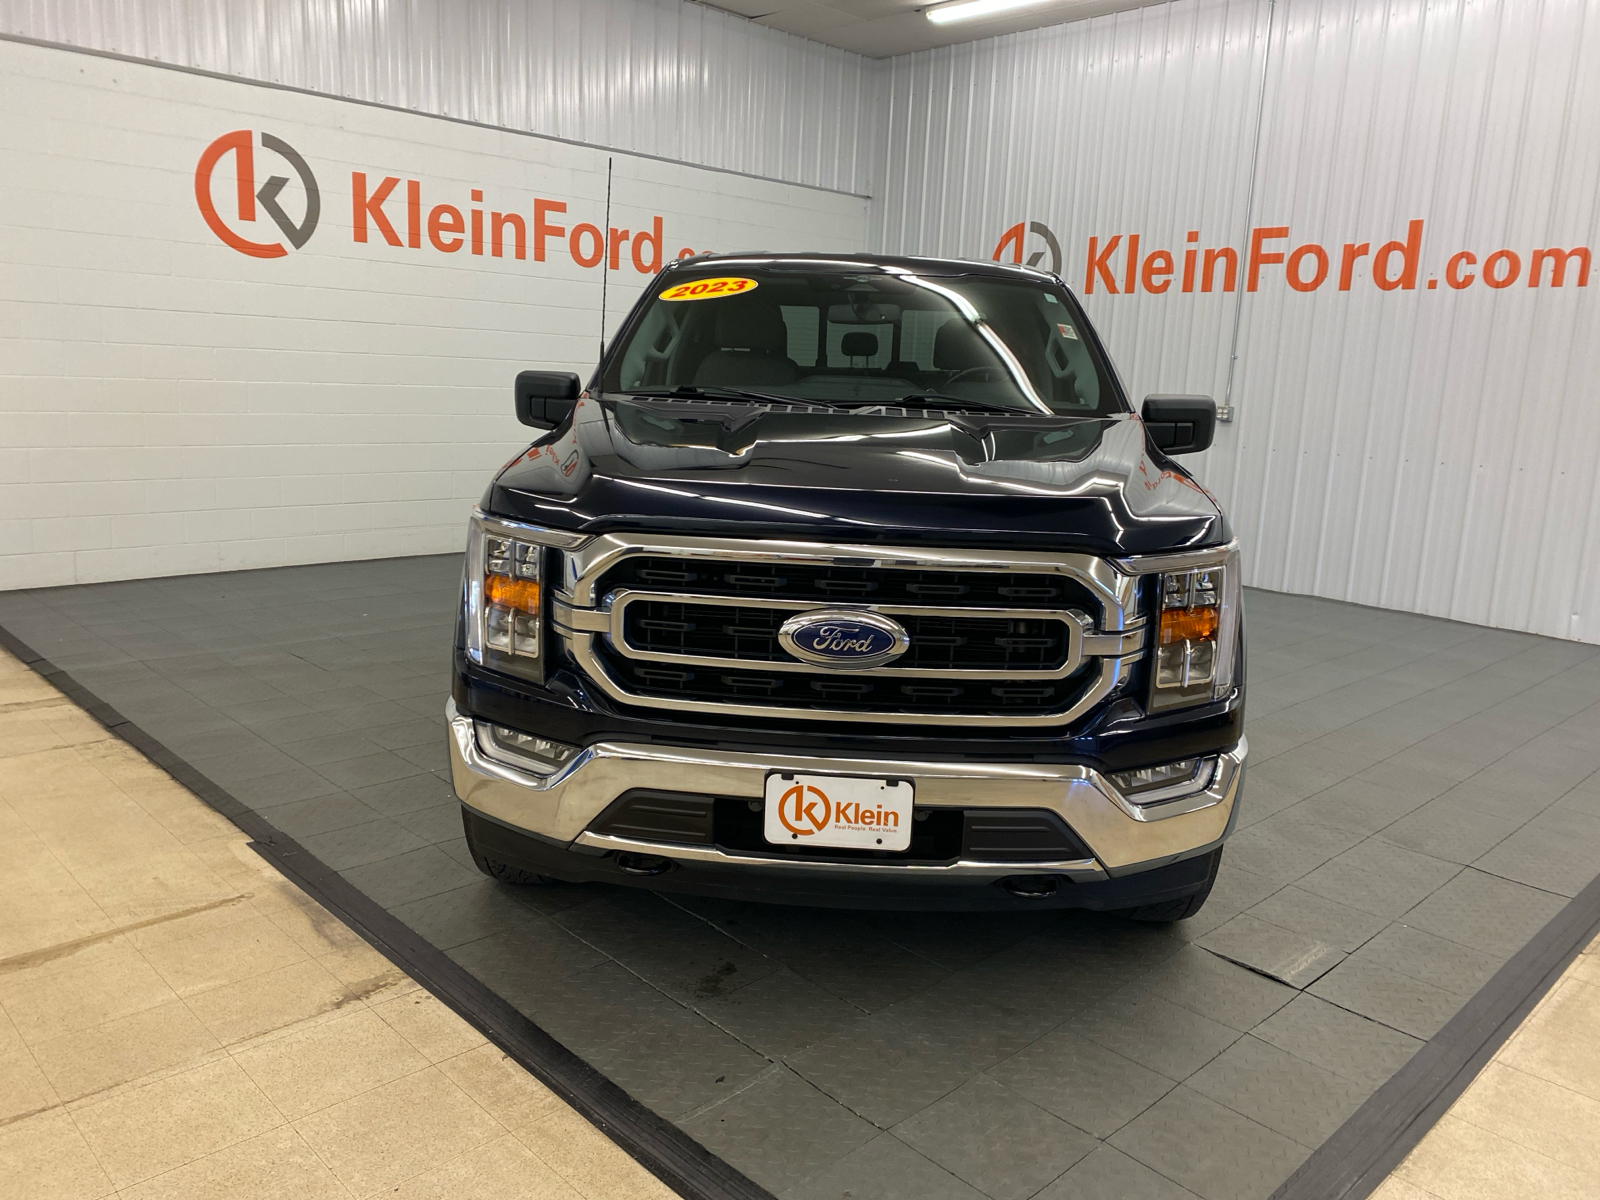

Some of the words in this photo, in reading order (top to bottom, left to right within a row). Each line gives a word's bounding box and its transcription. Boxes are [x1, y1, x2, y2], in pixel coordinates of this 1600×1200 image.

[351, 171, 712, 275] KleinFord
[1083, 219, 1591, 295] KleinFord.com
[668, 280, 748, 299] 2023
[812, 625, 875, 653] Ford
[834, 801, 899, 827] Klein
